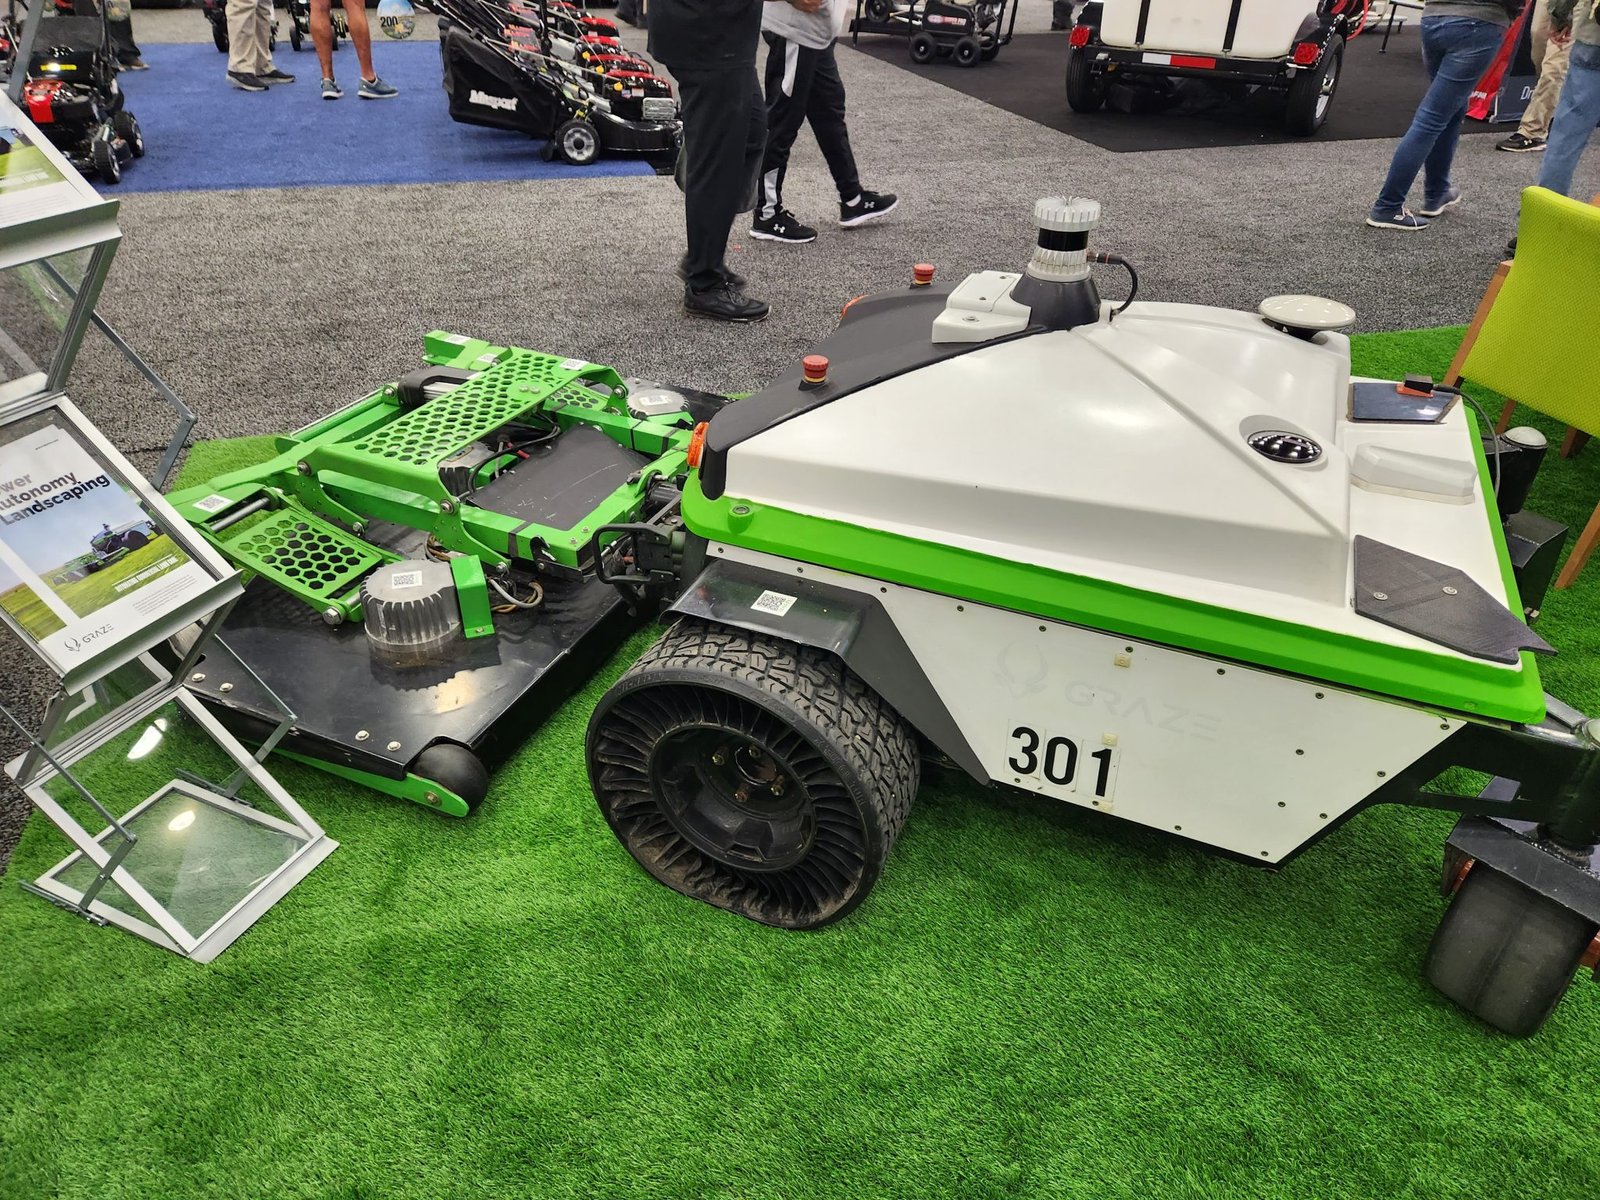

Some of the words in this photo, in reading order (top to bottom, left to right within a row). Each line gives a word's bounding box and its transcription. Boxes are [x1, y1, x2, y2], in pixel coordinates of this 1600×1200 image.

[380, 16, 399, 28] 200
[0, 474, 32, 494] wer
[0, 474, 111, 525] Landscaping
[1008, 726, 1112, 797] 301
